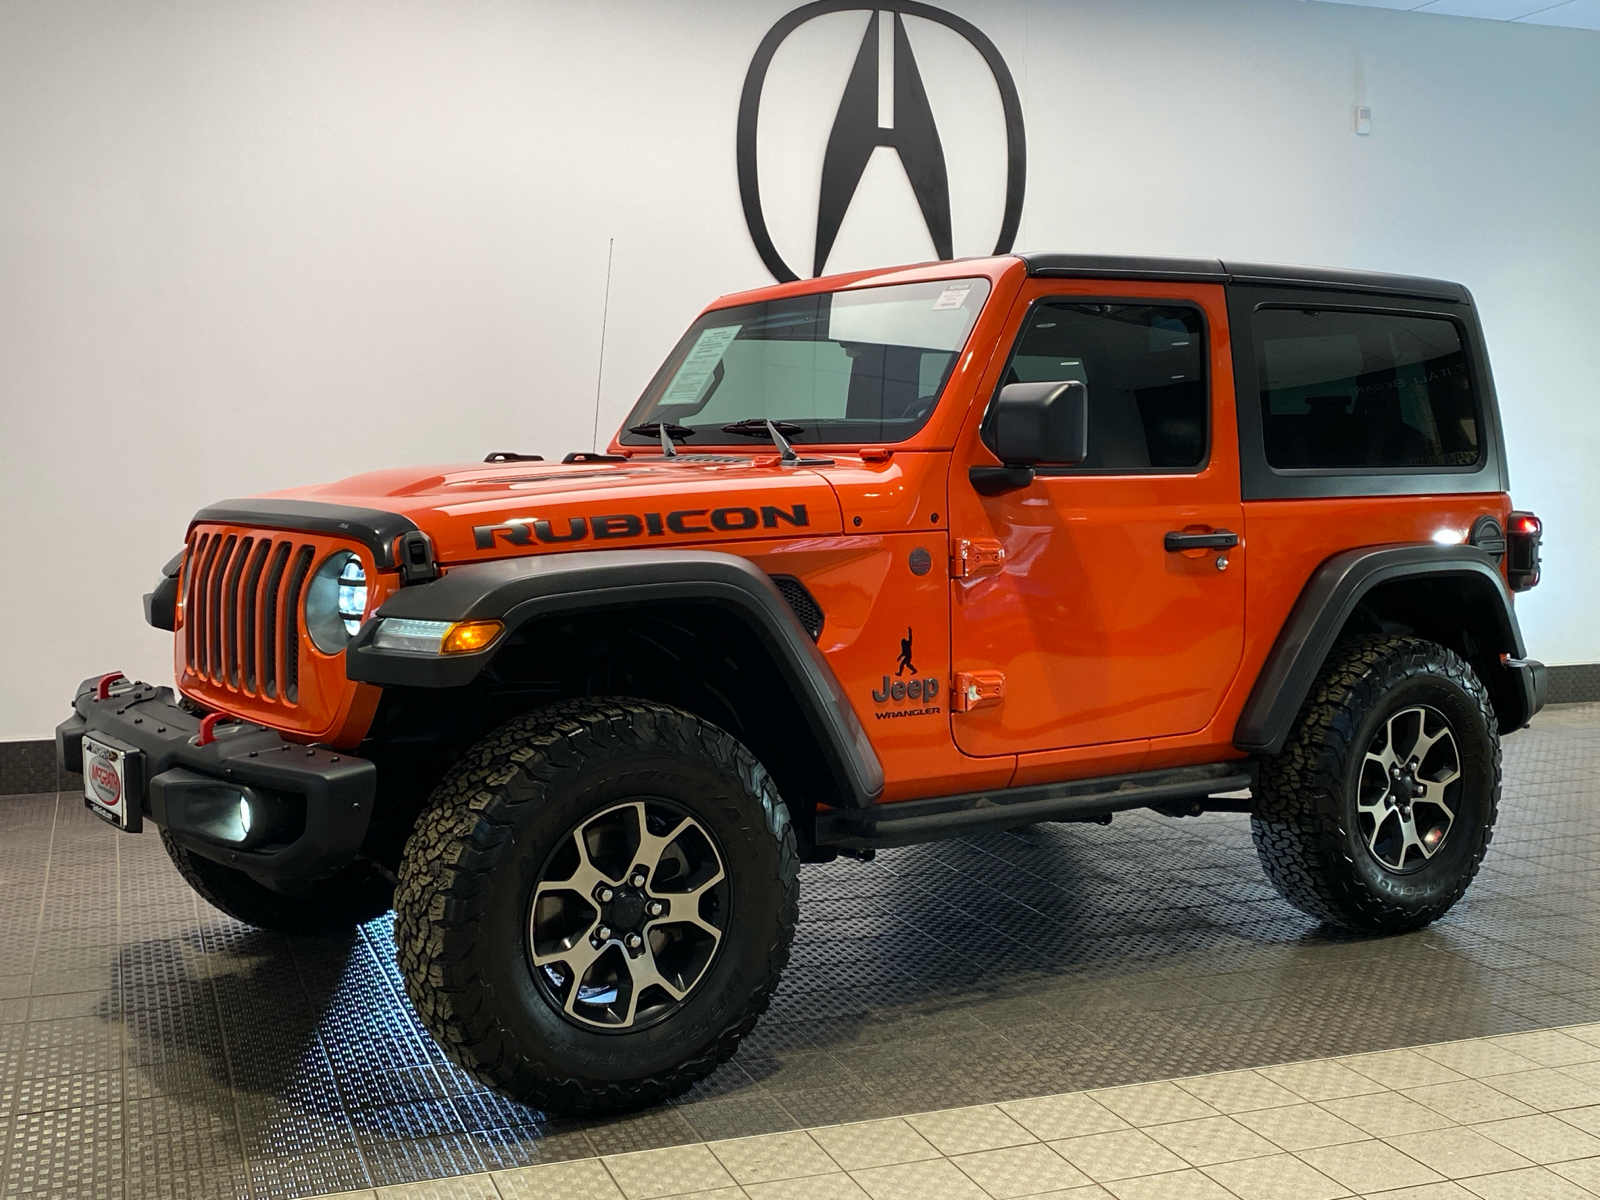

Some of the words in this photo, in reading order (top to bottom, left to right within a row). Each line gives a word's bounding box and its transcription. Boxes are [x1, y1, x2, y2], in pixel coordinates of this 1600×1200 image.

[472, 503, 809, 550] RUBICON
[872, 675, 939, 703] Jeep
[875, 706, 941, 720] WRANGLER
